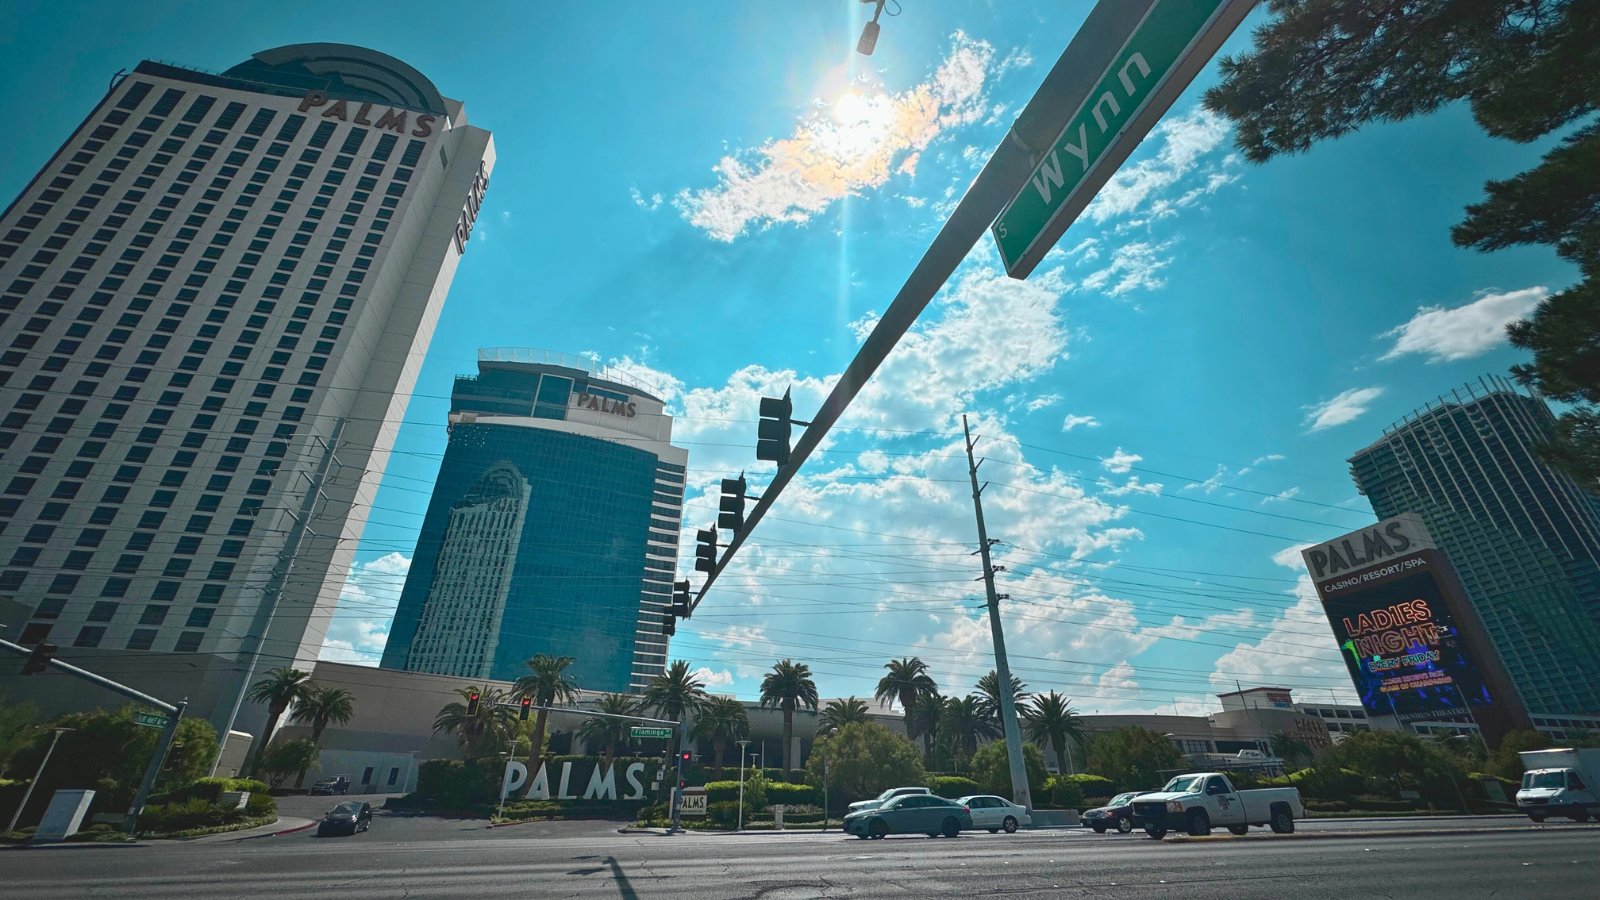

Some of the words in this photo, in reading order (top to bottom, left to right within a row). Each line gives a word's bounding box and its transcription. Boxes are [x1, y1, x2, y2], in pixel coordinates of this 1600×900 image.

[297, 90, 436, 138] PALMS
[998, 222, 1008, 239] S
[1031, 51, 1152, 205] Wynn
[453, 160, 490, 255] PALMS
[577, 391, 637, 418] PALMS
[1309, 521, 1410, 578] PALMS
[1324, 557, 1427, 593] CASINO/RESORT/SPA
[1343, 599, 1432, 637] LADIES
[1354, 622, 1439, 658] NIGHT
[1368, 657, 1400, 672] EVERY
[1400, 650, 1440, 667] FRIDAY
[634, 729, 665, 737] Flamingo
[500, 761, 645, 801] PALMS
